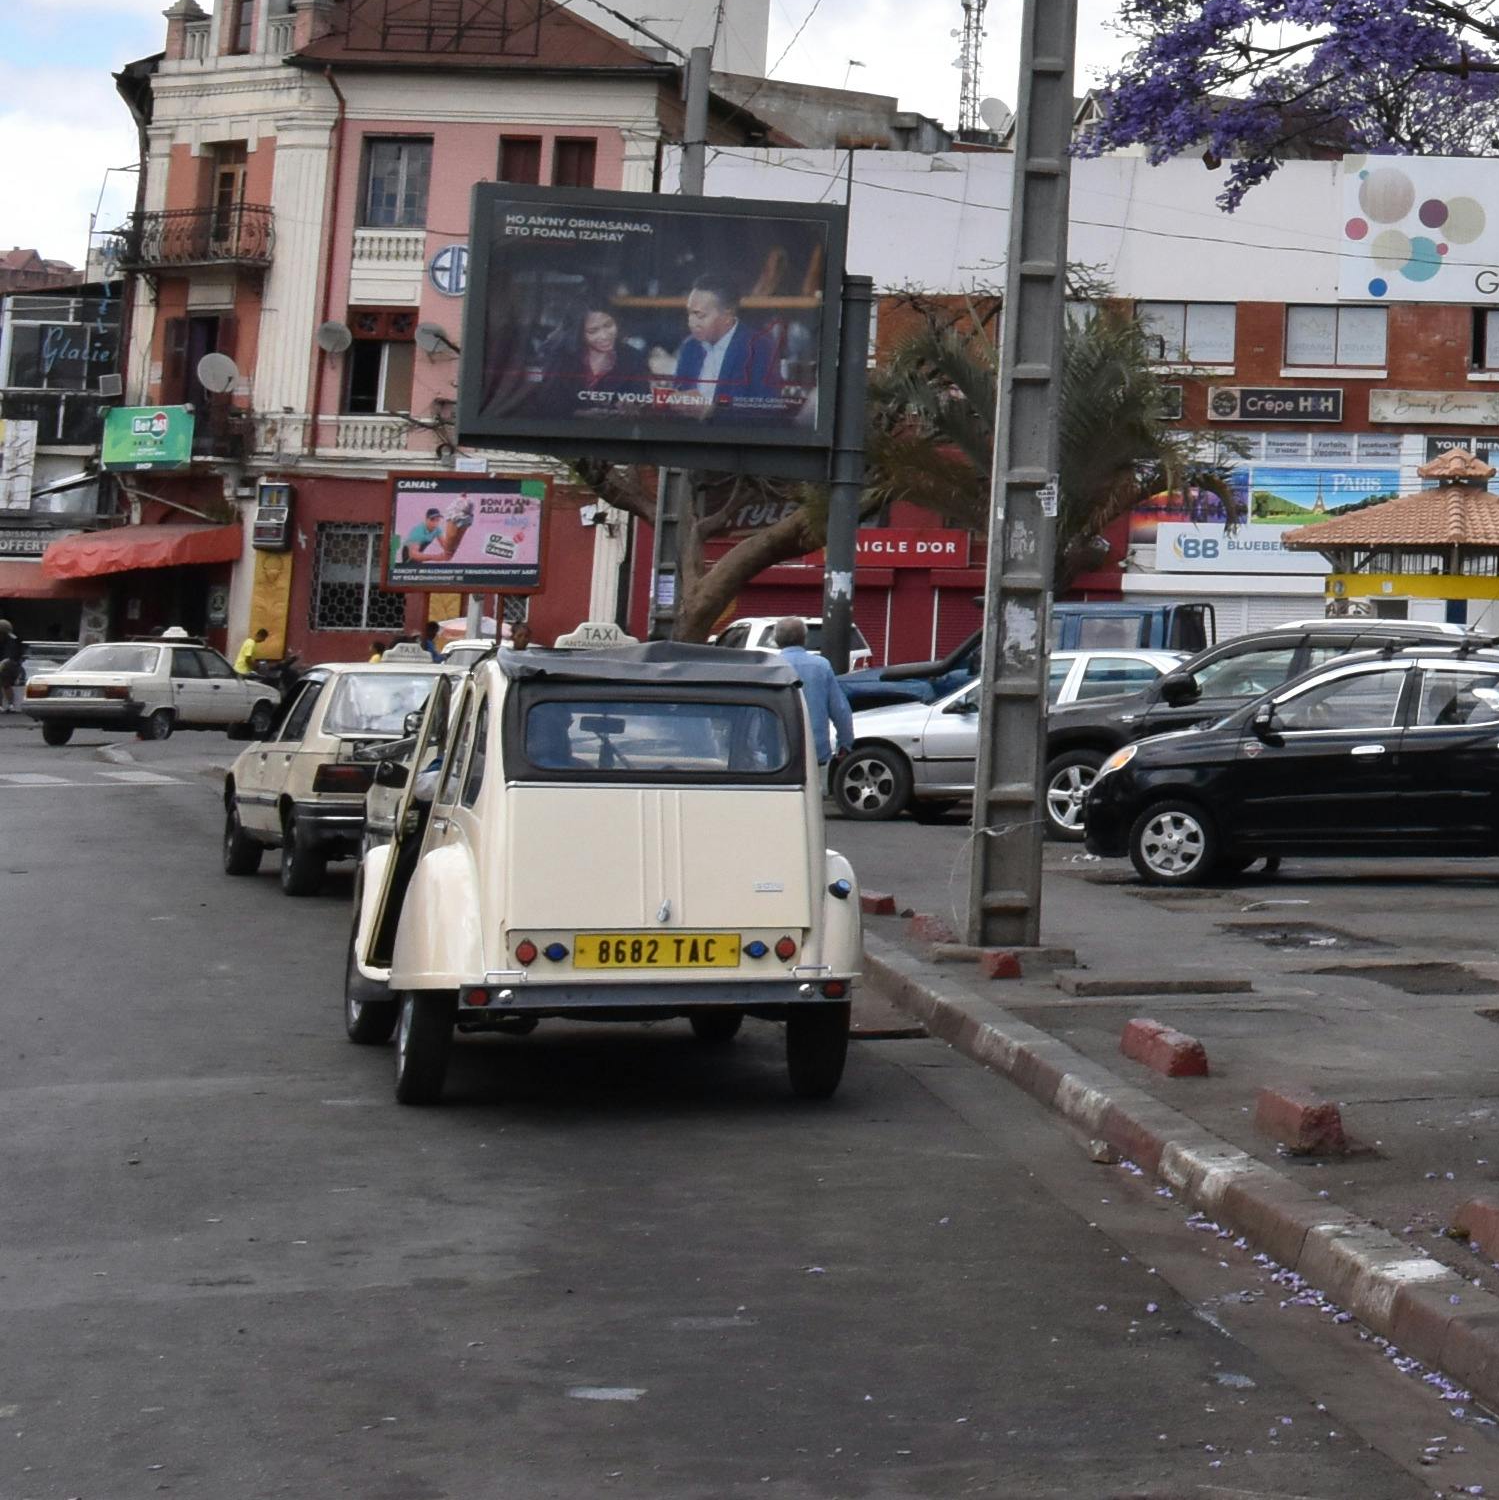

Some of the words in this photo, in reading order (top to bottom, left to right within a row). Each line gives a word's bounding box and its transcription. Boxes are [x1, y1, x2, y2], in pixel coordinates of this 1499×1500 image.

[505, 214, 526, 224] HO
[505, 226, 530, 236] ETO
[532, 228, 577, 239] FOANA
[579, 232, 625, 242] IZAHAY
[577, 390, 615, 401] C'EST
[618, 392, 653, 403] VOUS
[1435, 440, 1468, 450] YOUR
[397, 480, 439, 490] CANAL+
[726, 501, 801, 528] TYLE
[916, 541, 956, 553] D'OR
[1183, 537, 1220, 559] BB
[584, 627, 618, 641] TAXI
[597, 938, 660, 964] 8682
[674, 938, 717, 963] TAC
